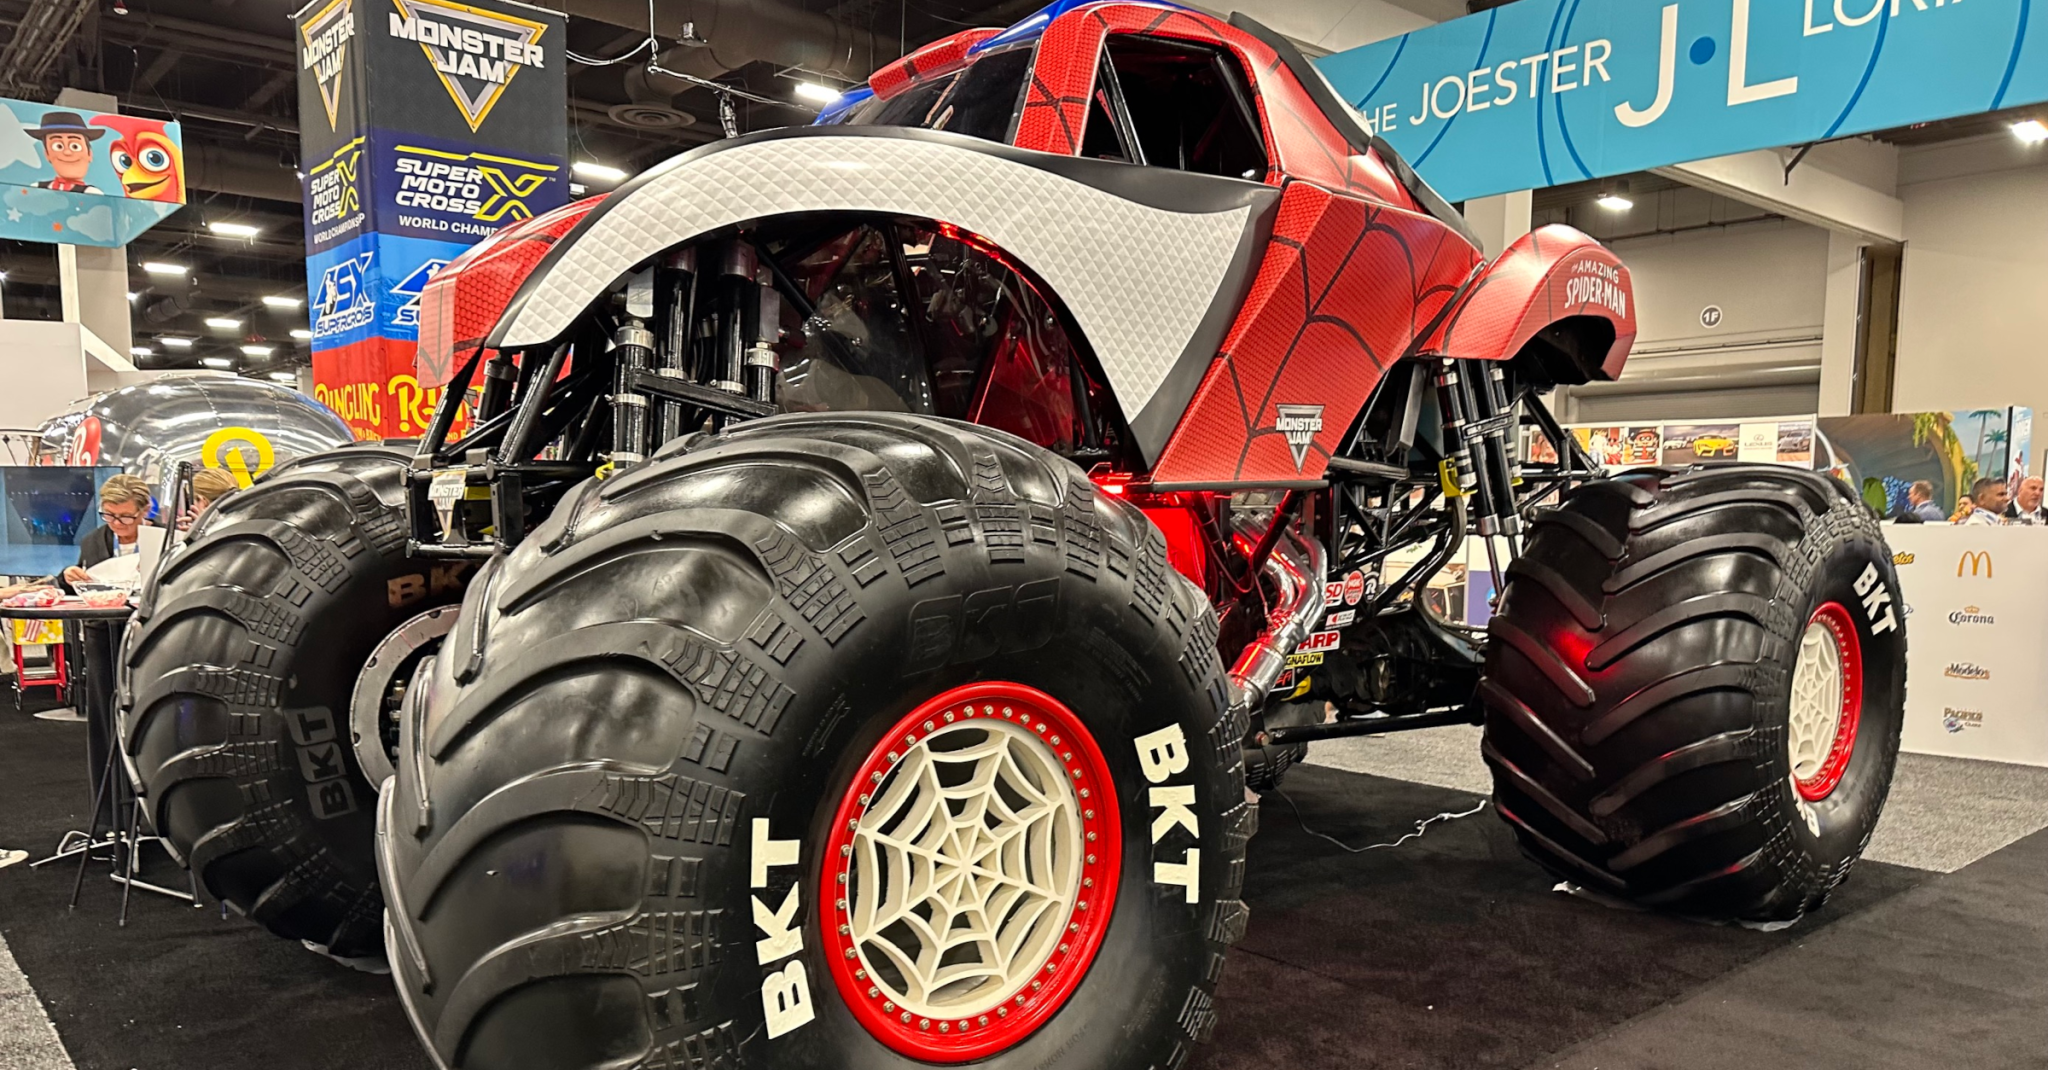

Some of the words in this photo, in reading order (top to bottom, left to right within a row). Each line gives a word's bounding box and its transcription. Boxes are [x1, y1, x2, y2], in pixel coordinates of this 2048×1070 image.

[303, 13, 355, 70] MONSTER
[389, 12, 544, 68] MONSTER
[320, 46, 341, 84] JAM
[437, 50, 505, 84] JAM
[1363, 103, 1397, 133] HE
[1409, 38, 1612, 126] JOESTER
[311, 168, 340, 195] SUPER
[395, 158, 483, 184] SUPER
[313, 185, 340, 209] MOTO
[401, 175, 480, 199] MOTO
[311, 200, 341, 225] CROSS
[395, 191, 482, 215] CROSS
[399, 215, 449, 231] WORLD
[451, 222, 498, 238] CHAMP
[1577, 260, 1619, 284] AMAZING
[1564, 276, 1626, 319] SPIDER-MAN
[1703, 311, 1719, 323] 1F
[1276, 417, 1323, 431] MONSTER
[1289, 431, 1311, 445] JAM
[1893, 551, 1915, 565] etos
[387, 560, 474, 607] BK
[1326, 583, 1343, 599] SD
[1853, 562, 1897, 635] BKT
[1948, 610, 1995, 626] Corona
[1286, 653, 1322, 665] GNAFLOW
[296, 711, 350, 816] BKT
[1133, 722, 1200, 903] BKT
[751, 817, 815, 1039] BKT
